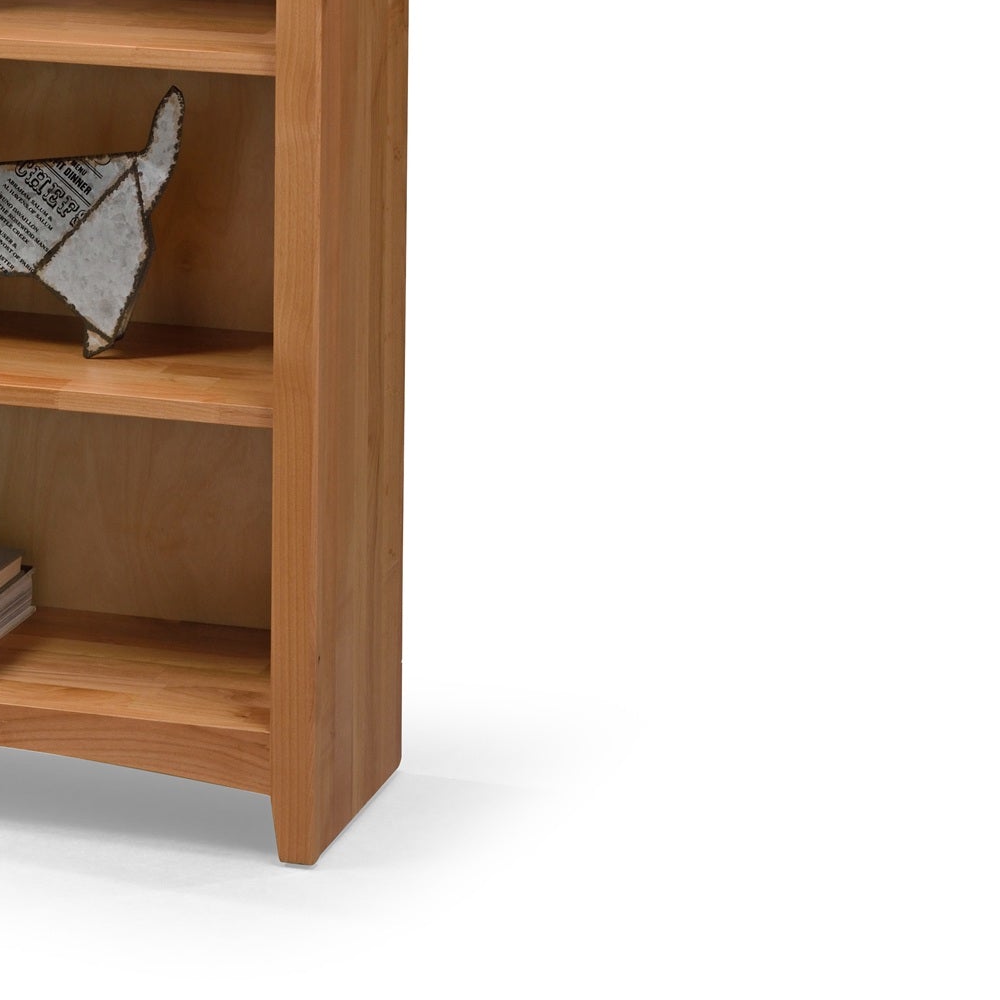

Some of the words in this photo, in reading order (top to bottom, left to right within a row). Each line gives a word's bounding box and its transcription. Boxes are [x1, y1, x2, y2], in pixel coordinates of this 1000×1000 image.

[63, 167, 93, 196] DINNER
[7, 177, 32, 201] ABRAHAM
[30, 199, 49, 217] SALUM
[8, 213, 36, 240] ROSEWOOD
[33, 236, 50, 253] MANS
[28, 207, 37, 216] OF
[35, 213, 54, 232] SALUM
[12, 227, 30, 245] CREEK
[12, 251, 21, 261] OF
